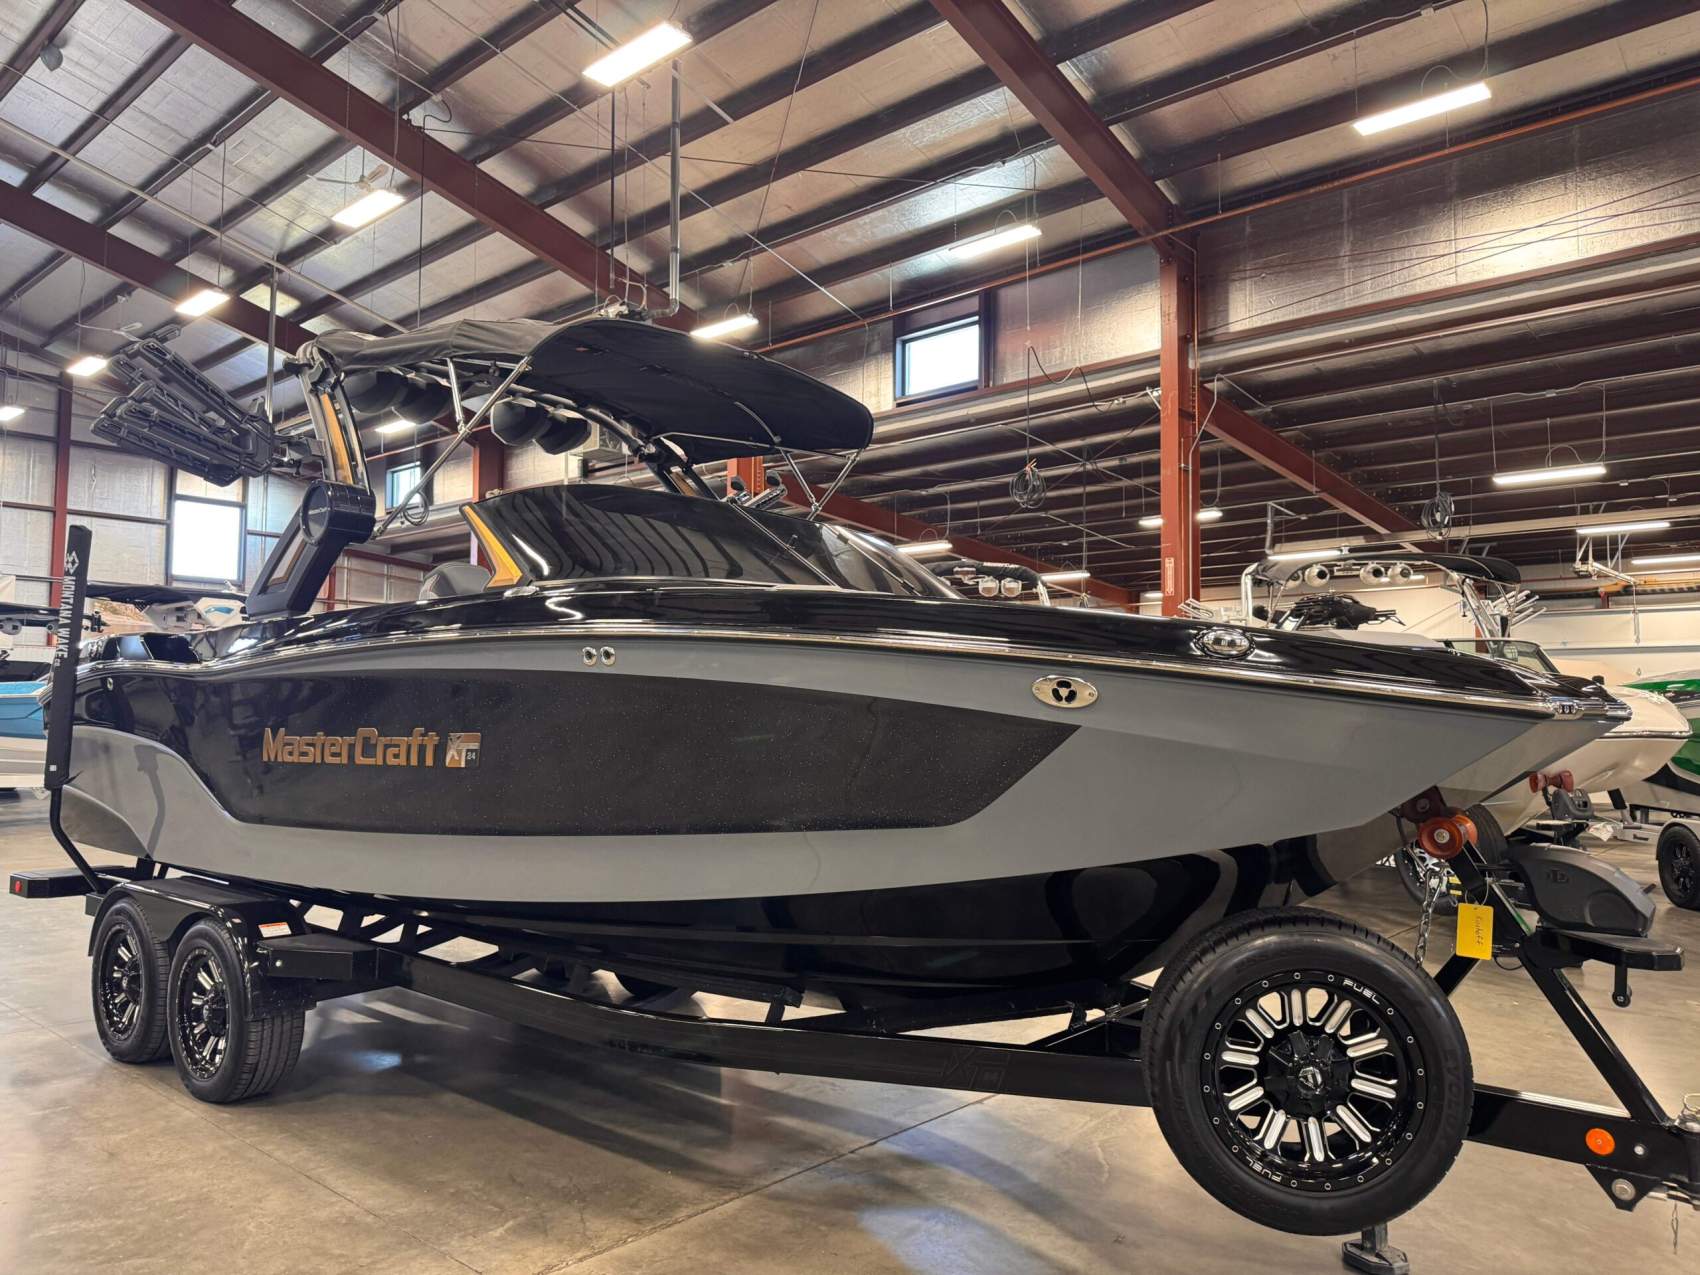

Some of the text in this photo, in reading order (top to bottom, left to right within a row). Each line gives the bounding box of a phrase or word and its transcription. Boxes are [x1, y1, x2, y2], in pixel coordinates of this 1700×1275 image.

[59, 575, 76, 624] MONTANA
[56, 628, 71, 658] WAKE
[261, 727, 440, 767] MasterCraft
[1343, 977, 1380, 1005] FUEL
[1246, 1155, 1284, 1183] FUEL
